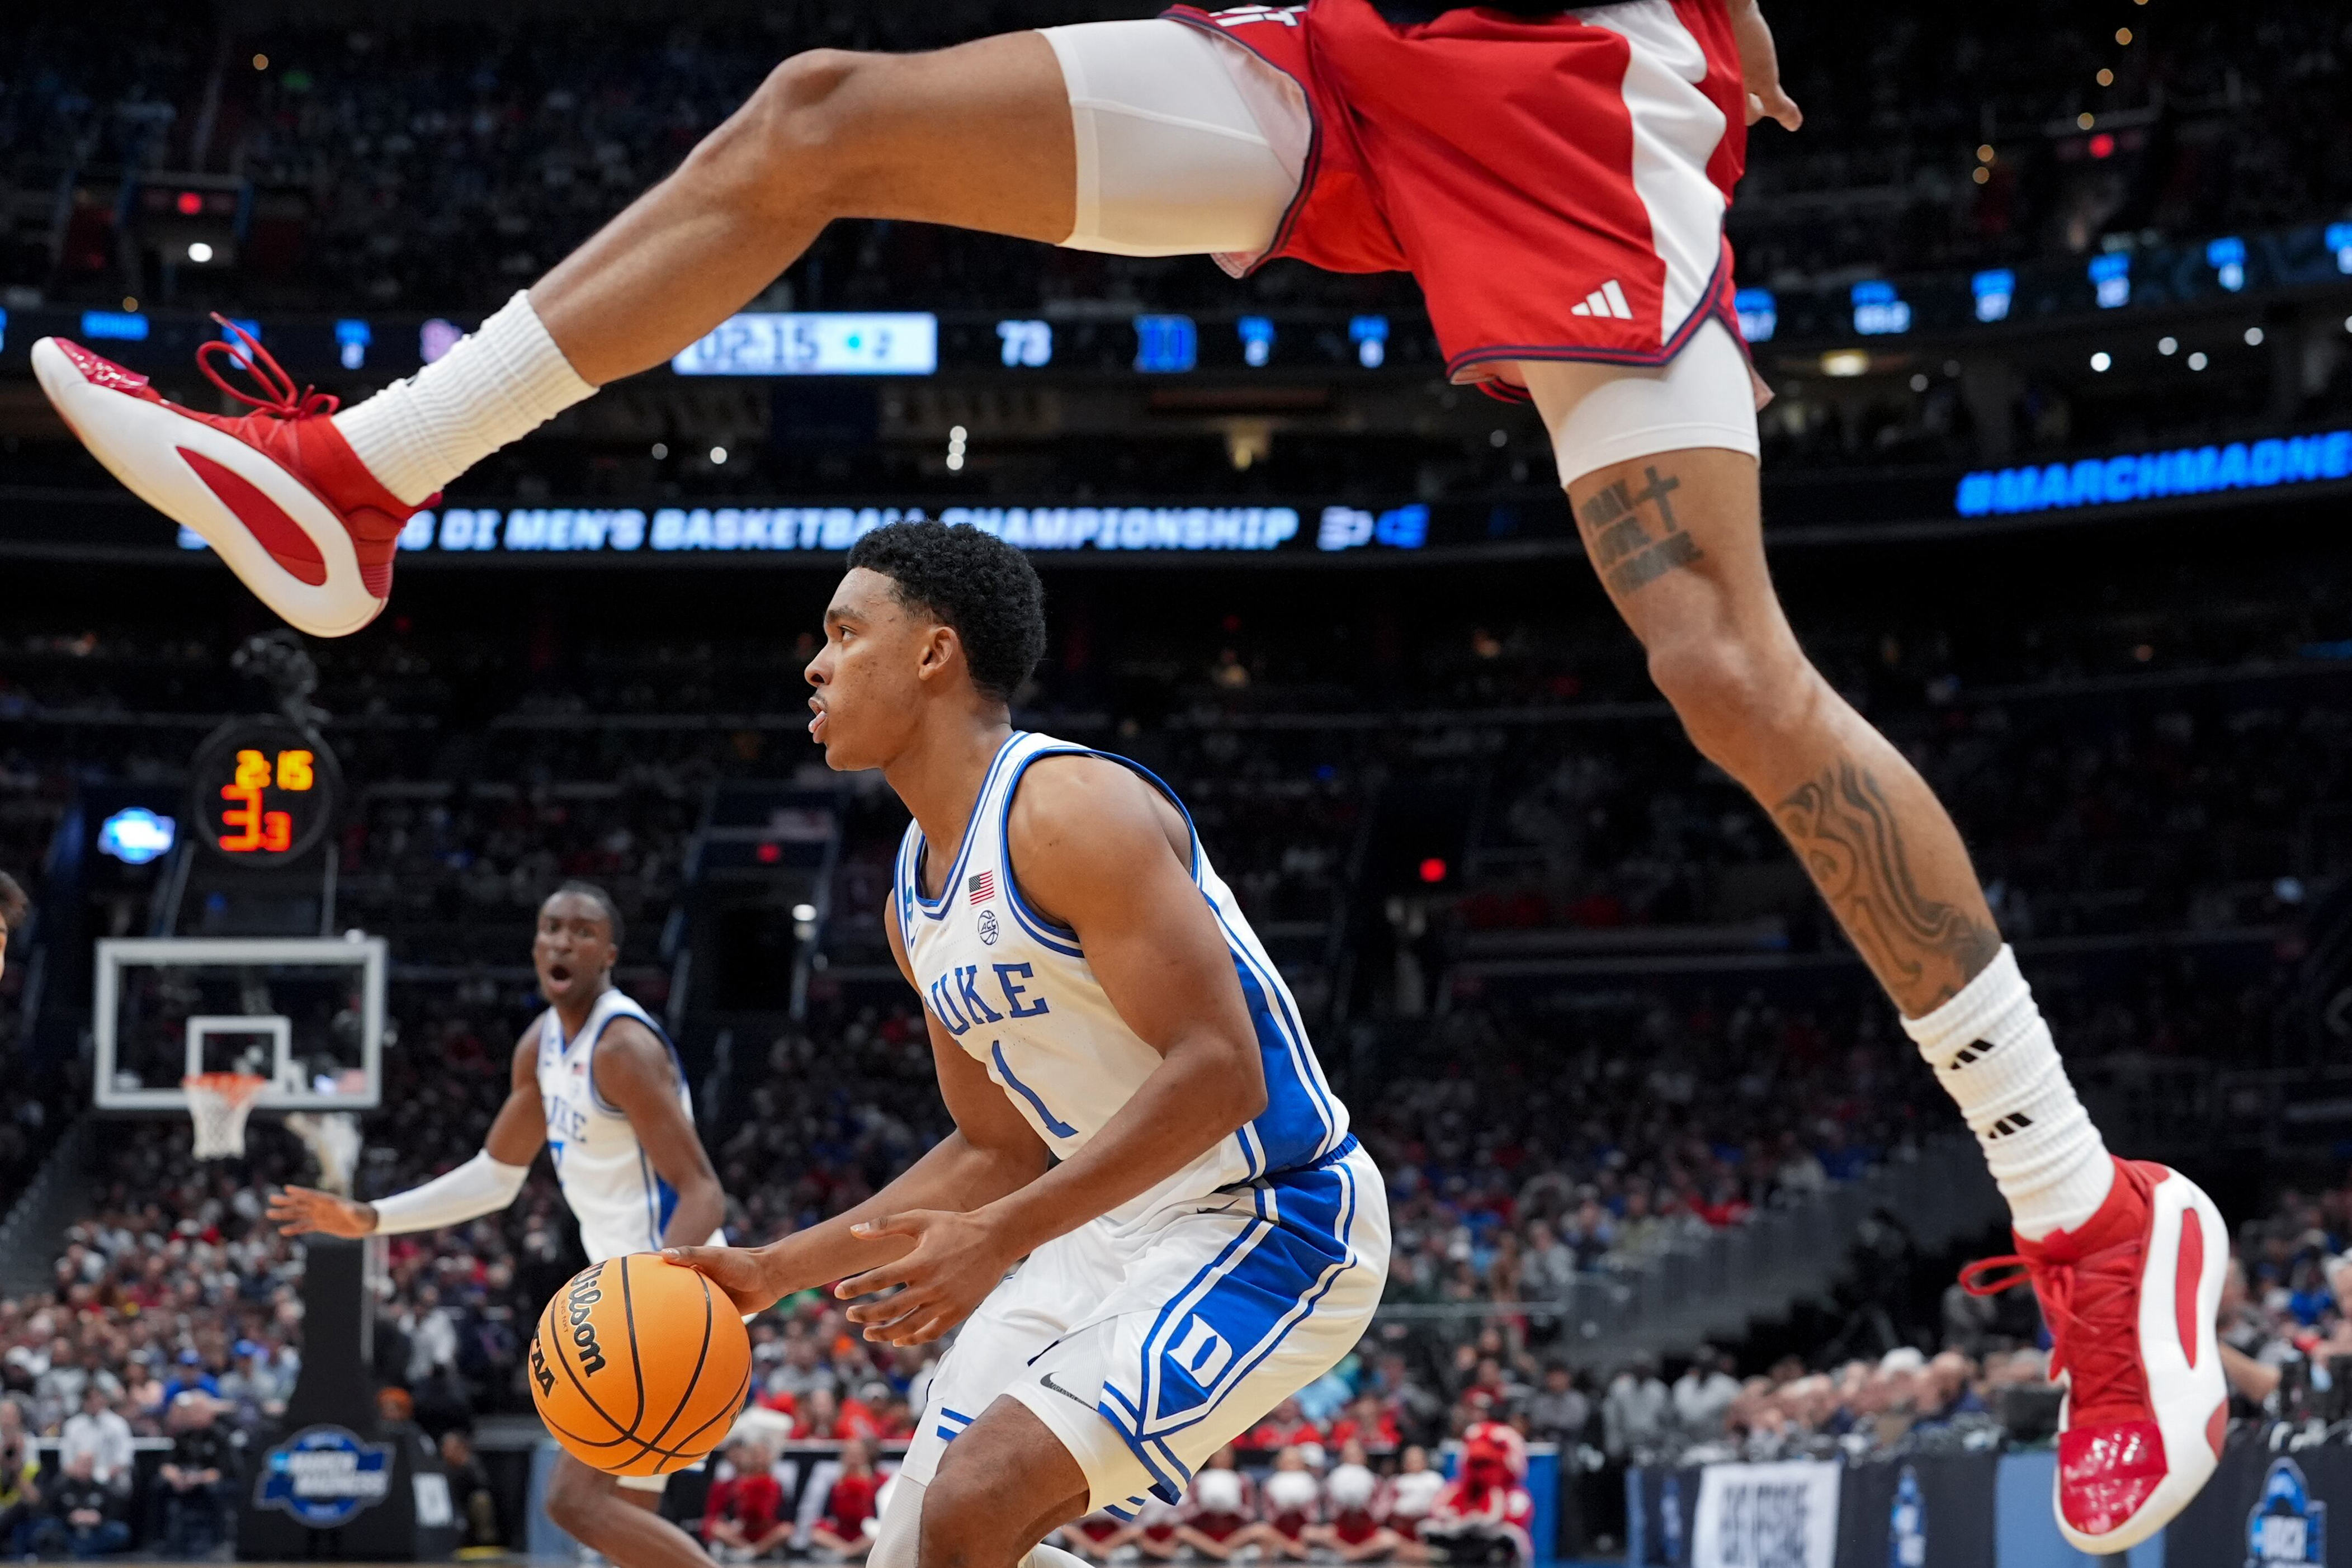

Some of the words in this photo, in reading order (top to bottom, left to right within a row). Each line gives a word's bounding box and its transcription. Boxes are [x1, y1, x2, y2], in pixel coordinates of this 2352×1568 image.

[504, 508, 647, 550] MEN'S
[923, 962, 1050, 1036] UKE
[992, 1040, 1079, 1139] 1
[569, 1259, 608, 1378] Wilson
